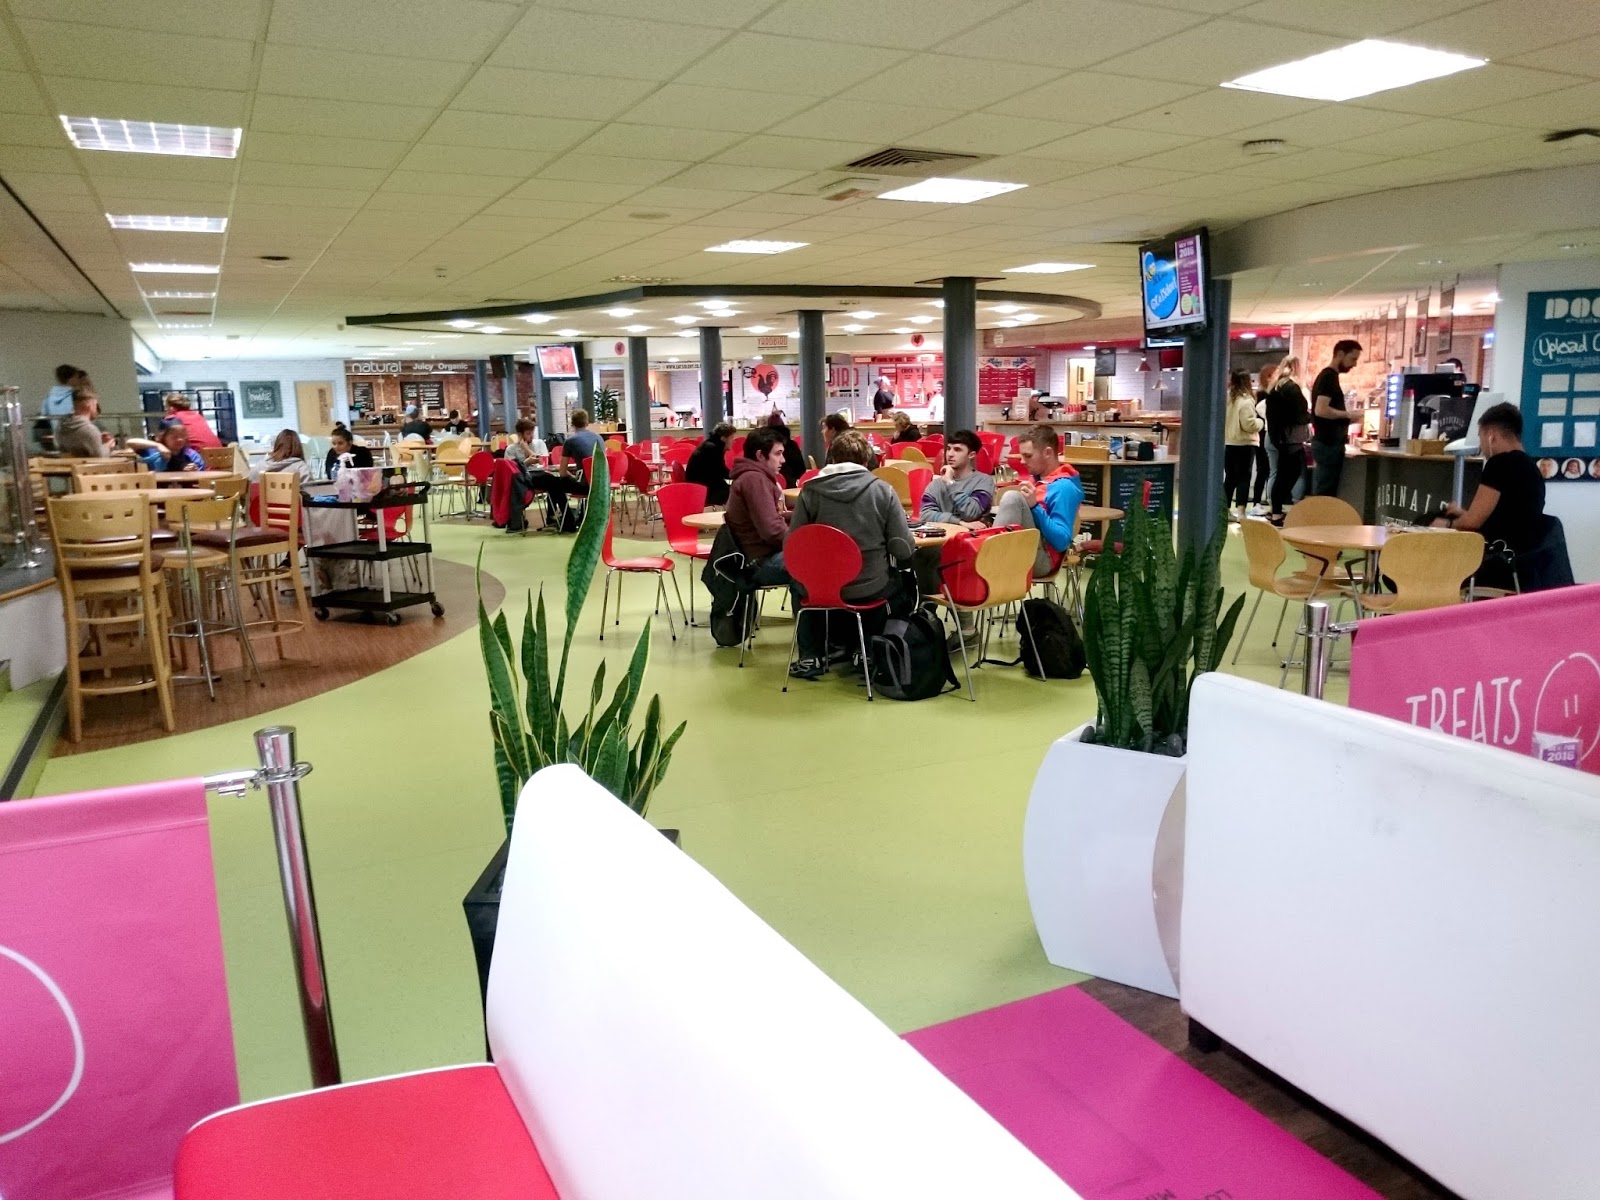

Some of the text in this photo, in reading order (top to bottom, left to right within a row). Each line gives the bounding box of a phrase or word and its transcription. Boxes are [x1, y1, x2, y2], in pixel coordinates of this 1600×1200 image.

[757, 337, 788, 346] YARDBIRD
[1538, 333, 1588, 360] Upload
[351, 361, 468, 373] natural Juicy Organic
[1405, 676, 1522, 746] TREATS
